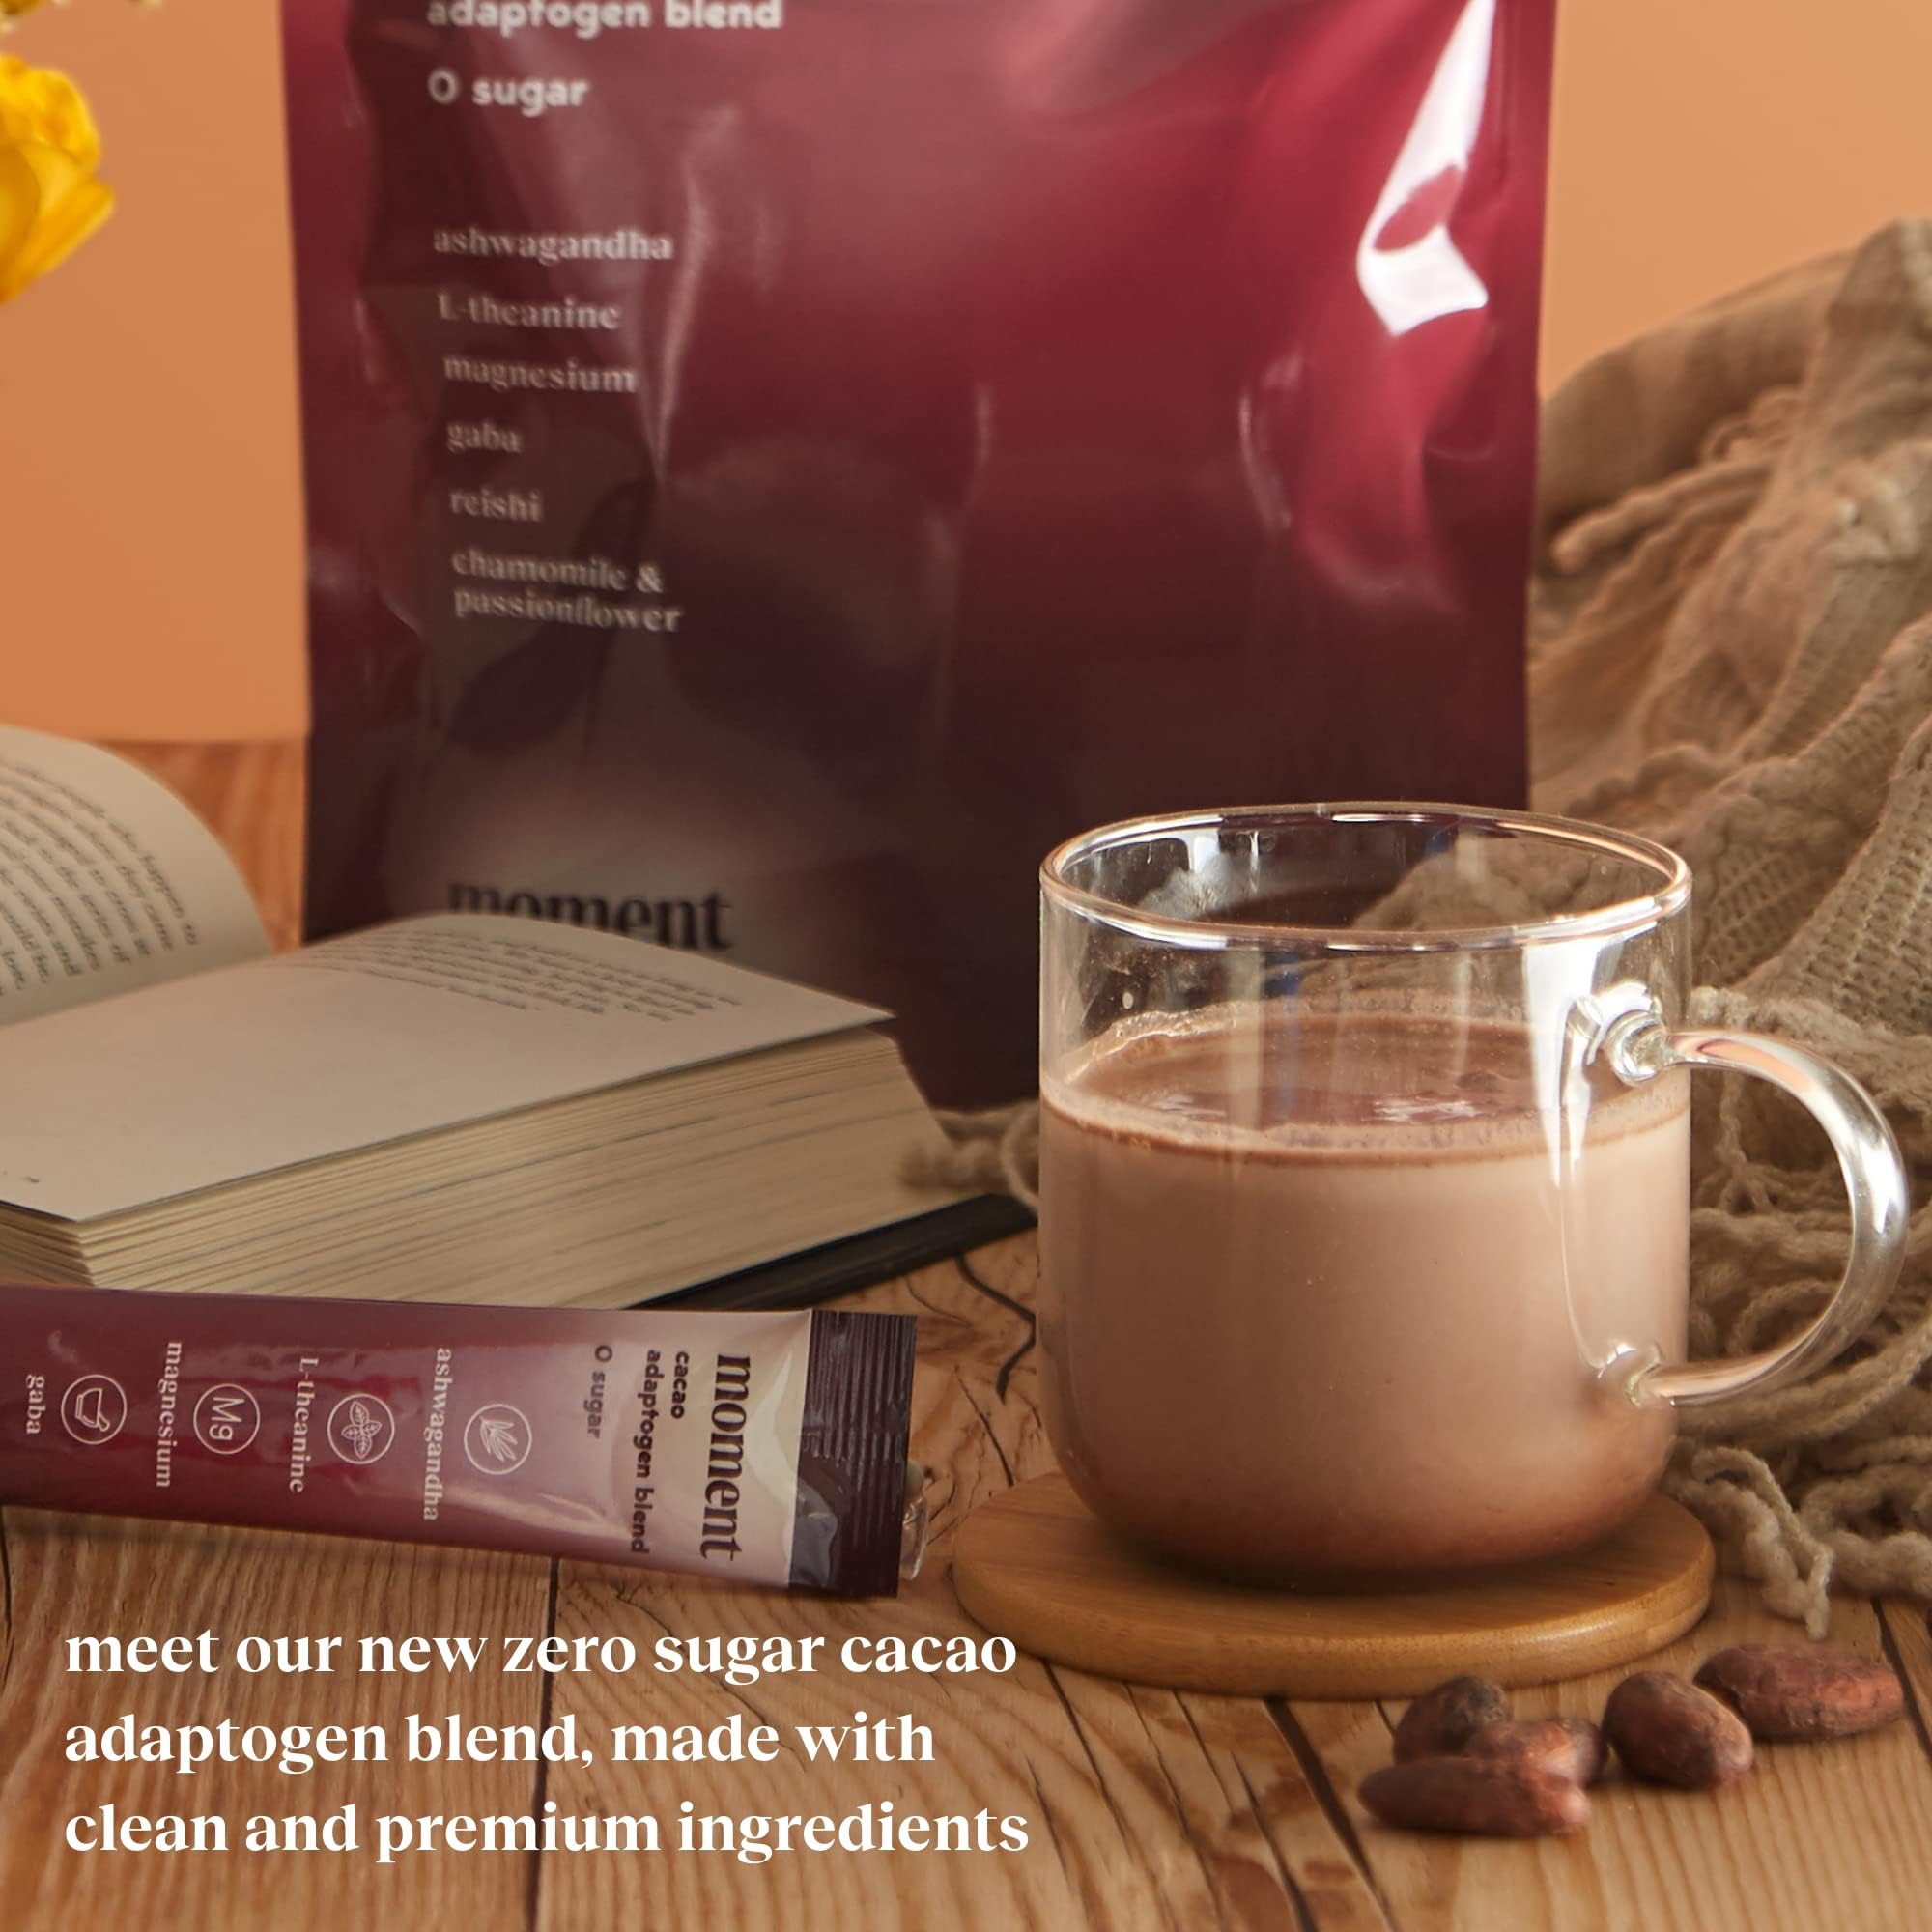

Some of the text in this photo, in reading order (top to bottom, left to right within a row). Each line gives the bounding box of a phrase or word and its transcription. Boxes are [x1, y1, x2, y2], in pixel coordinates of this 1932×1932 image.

[427, 0, 784, 37] adaptogen blend
[471, 77, 590, 117] sugar
[434, 226, 673, 265] ashwagandha
[437, 292, 620, 330] L-theanine
[443, 355, 637, 393] magnesium
[446, 418, 521, 453] gaba
[449, 487, 542, 522] reishi
[450, 549, 664, 593] chamomile &
[453, 586, 681, 631] passionflower
[25, 1374, 47, 1435] gaba
[582, 1369, 609, 1440] sugar
[670, 1350, 691, 1421] cacao
[156, 1342, 184, 1489] magnesium
[208, 1396, 243, 1442] Mg
[289, 1356, 320, 1493] L-theanine
[423, 1348, 454, 1522] ashwagandha
[630, 1349, 665, 1554] adaptogen blend
[699, 1353, 752, 1562] moment
